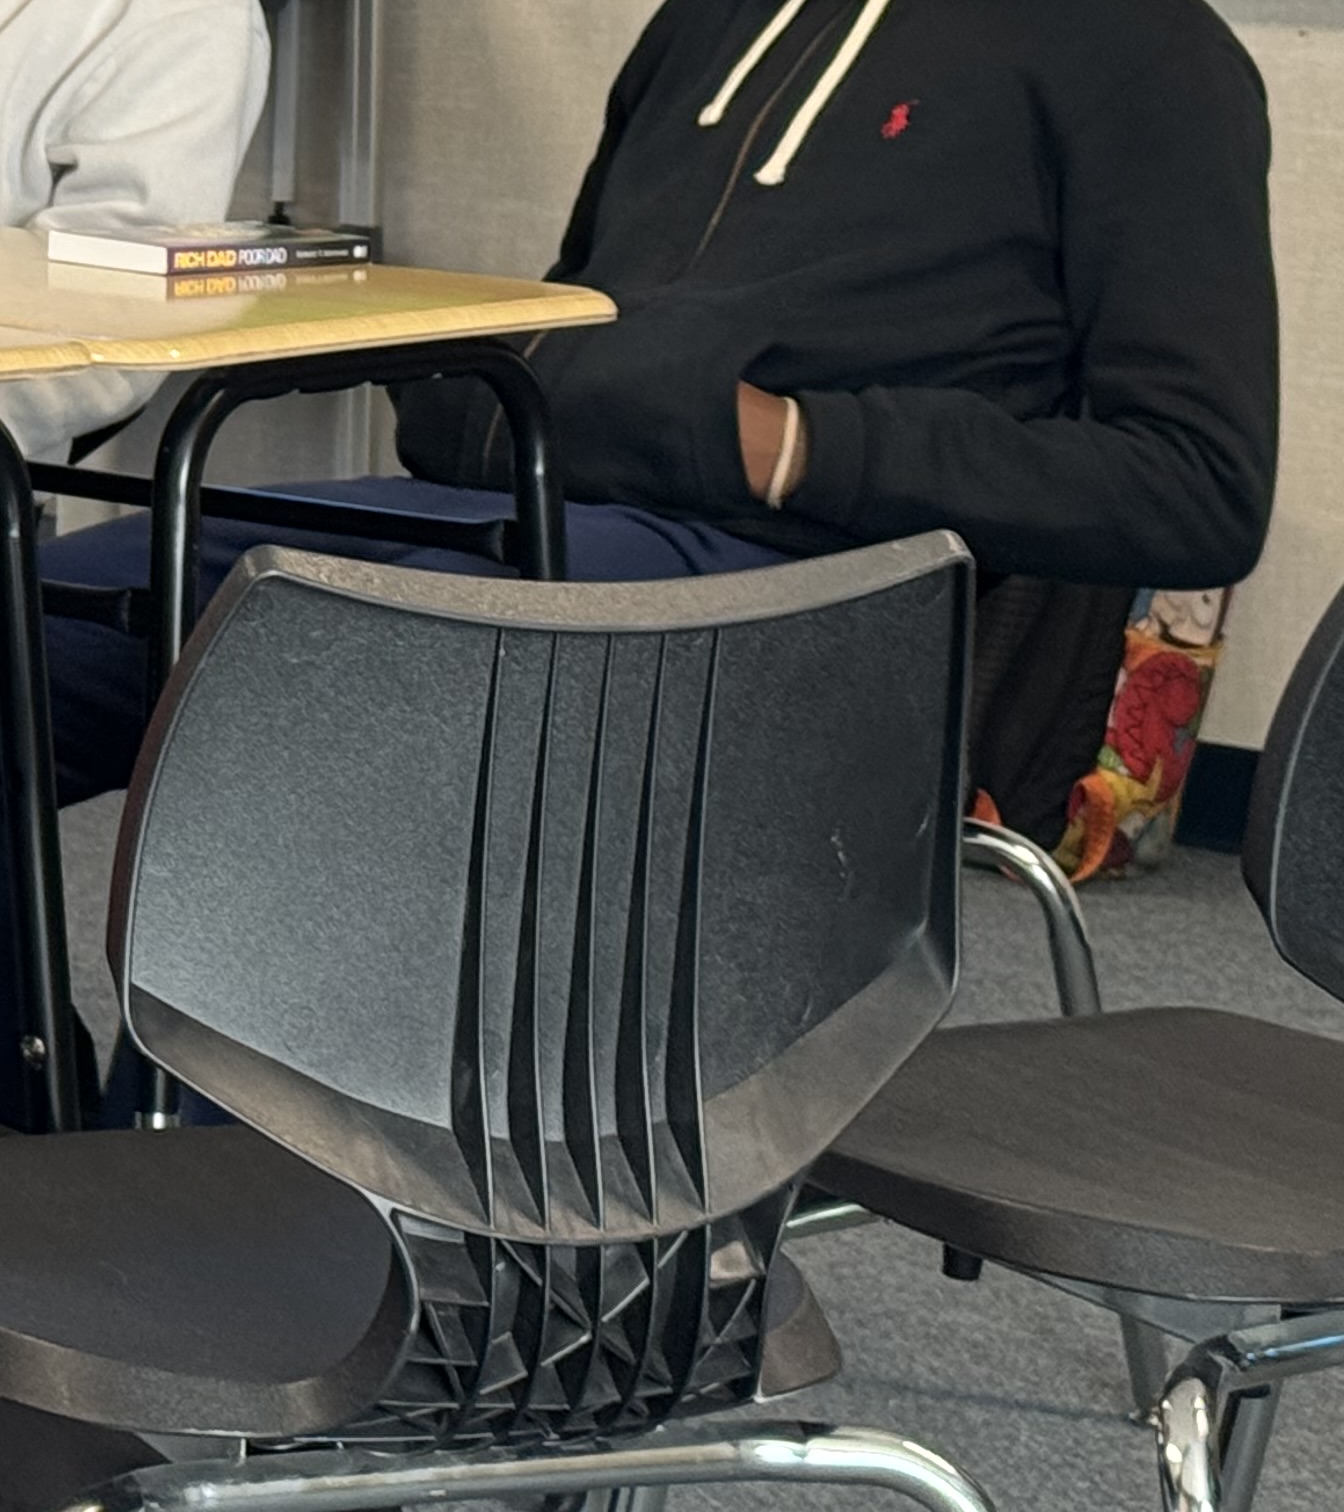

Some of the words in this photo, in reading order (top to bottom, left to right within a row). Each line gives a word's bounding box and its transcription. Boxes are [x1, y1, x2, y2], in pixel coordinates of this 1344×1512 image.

[174, 251, 205, 269] RICH
[206, 249, 237, 267] DAD
[238, 248, 266, 266] POOR
[265, 247, 288, 264] DAD
